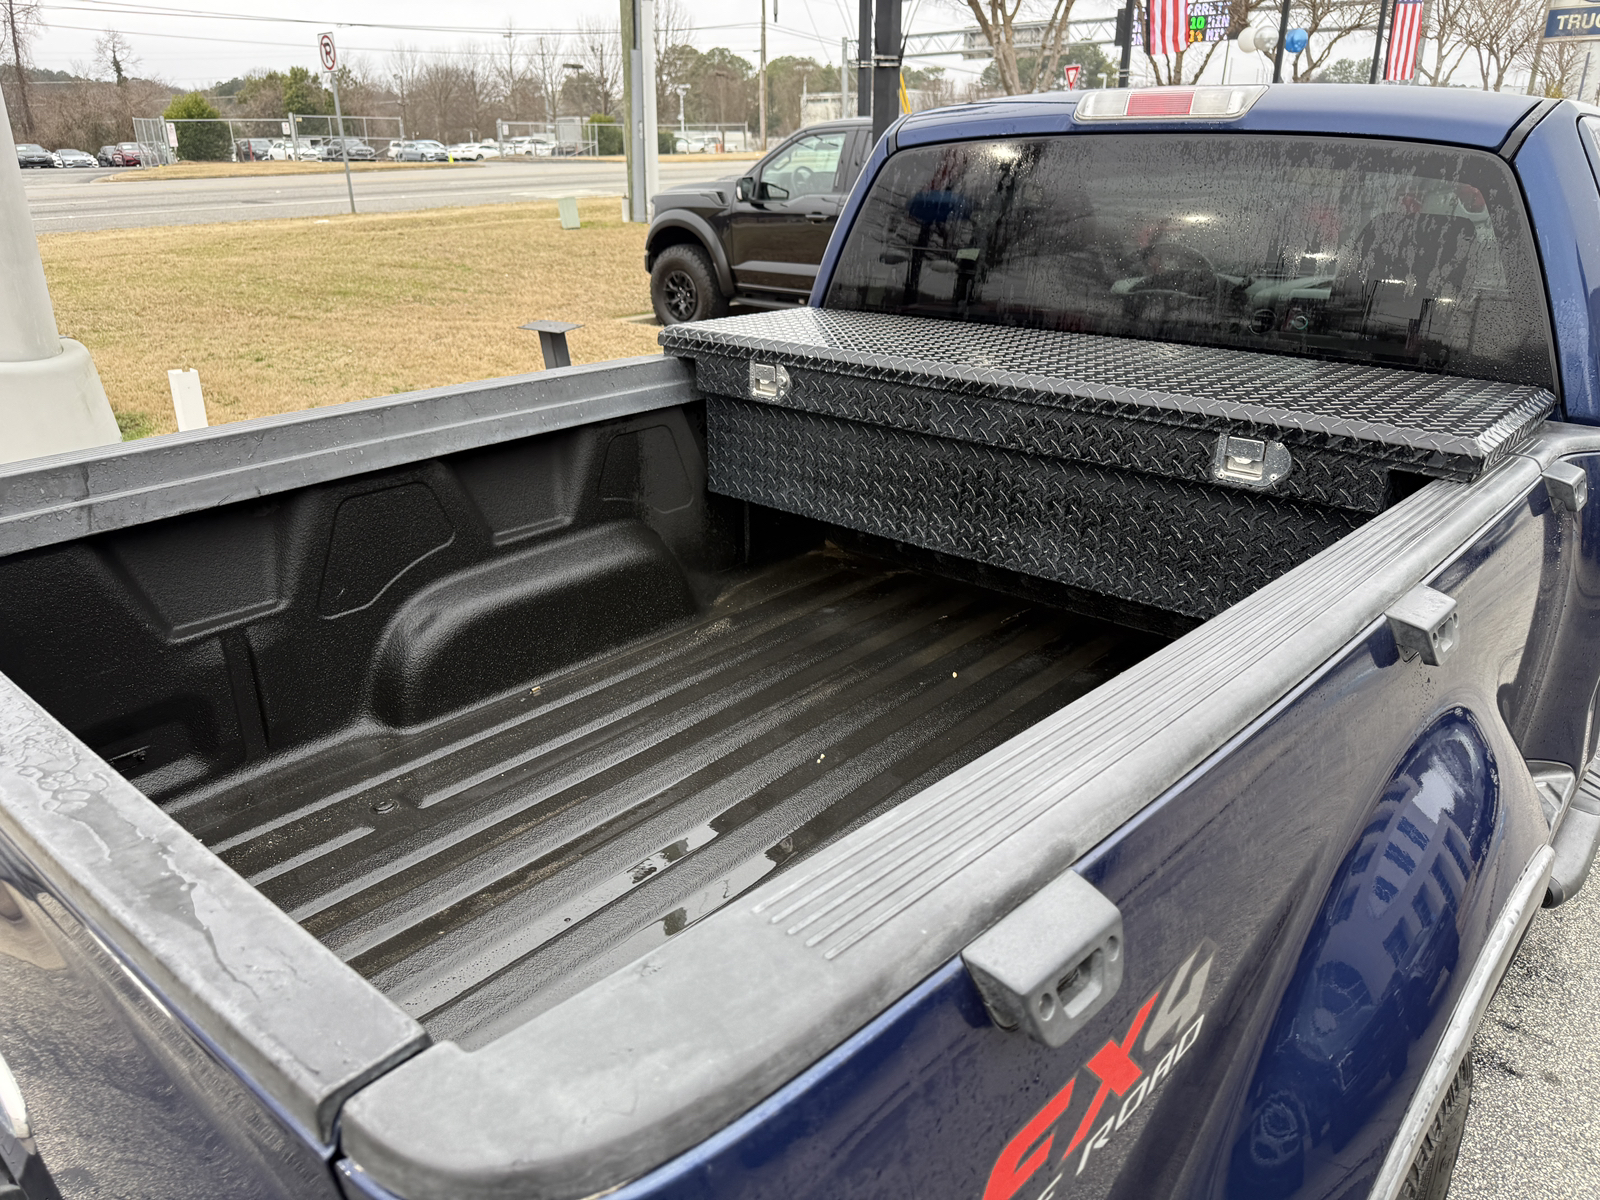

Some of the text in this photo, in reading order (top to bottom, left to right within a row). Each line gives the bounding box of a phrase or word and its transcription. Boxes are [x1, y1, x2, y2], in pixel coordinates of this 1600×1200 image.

[1190, 16, 1205, 30] 10
[982, 939, 1218, 1200] FX4
[1075, 1014, 1205, 1176] ROAD
